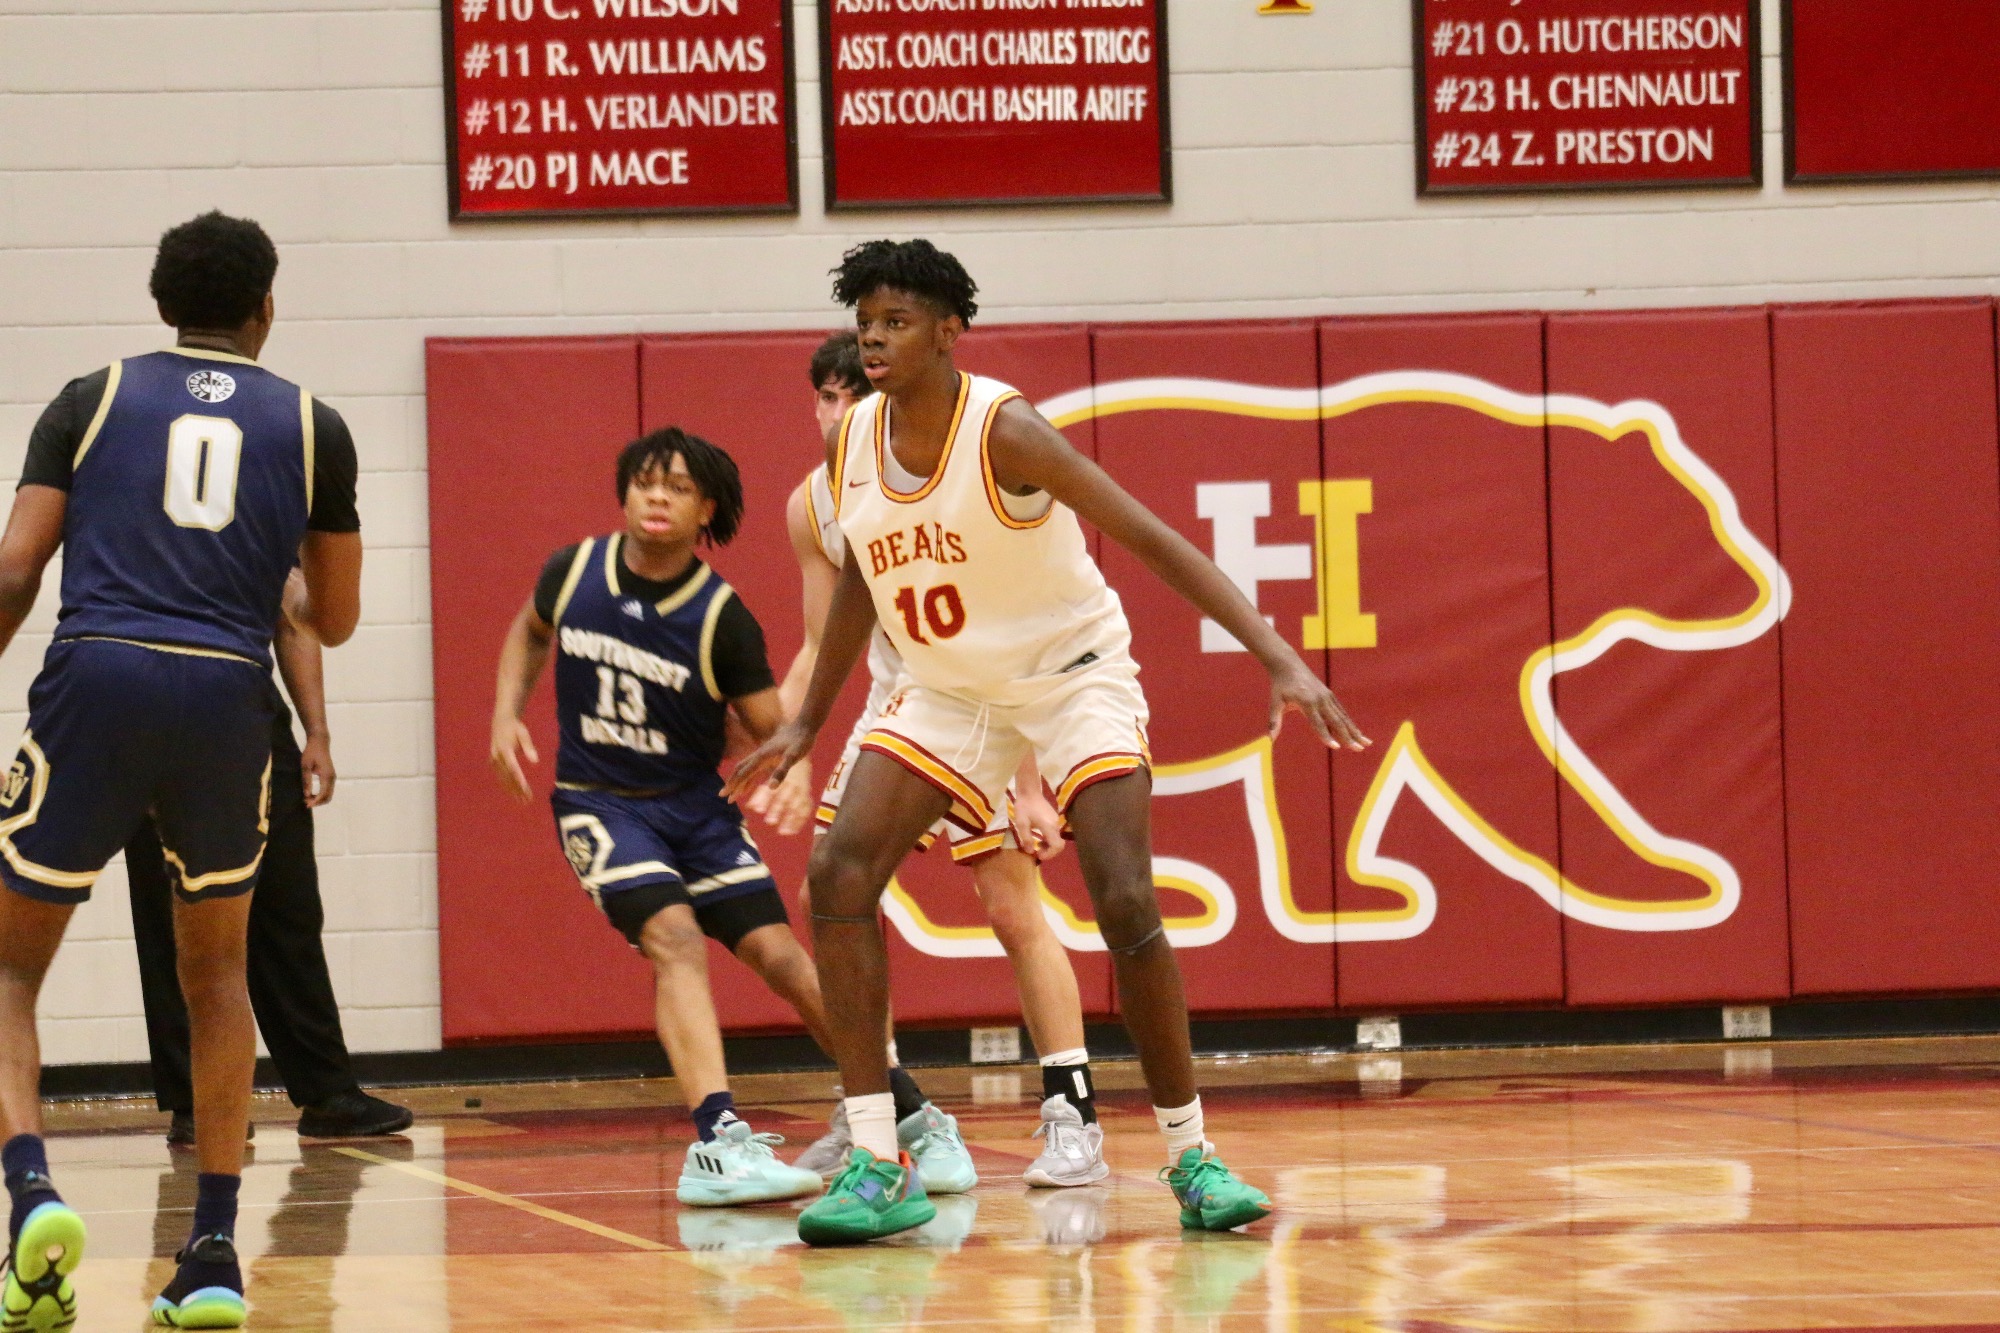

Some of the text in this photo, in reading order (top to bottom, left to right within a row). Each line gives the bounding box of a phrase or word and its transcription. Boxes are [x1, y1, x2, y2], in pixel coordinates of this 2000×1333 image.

[461, 0, 738, 22] #10 C. WILSON
[838, 27, 1150, 70] ASST. COACH CHARLES TRIGG
[1432, 15, 1741, 56] #21 O. HUTCHERSON
[464, 37, 766, 78] #11 R. WILLIAMS
[840, 86, 1147, 125] ASST. COACH BASHIR ARIFF
[1434, 71, 1740, 112] #23 H. CHENNAULT
[466, 92, 778, 134] #12 H. VERLANDER
[1433, 128, 1712, 167] #24 Z. PRESTON
[467, 149, 688, 194] #20 PJ MACE
[163, 413, 243, 533] 0
[867, 521, 968, 578] BEARS
[893, 584, 967, 646] 10
[595, 666, 648, 726] 13
